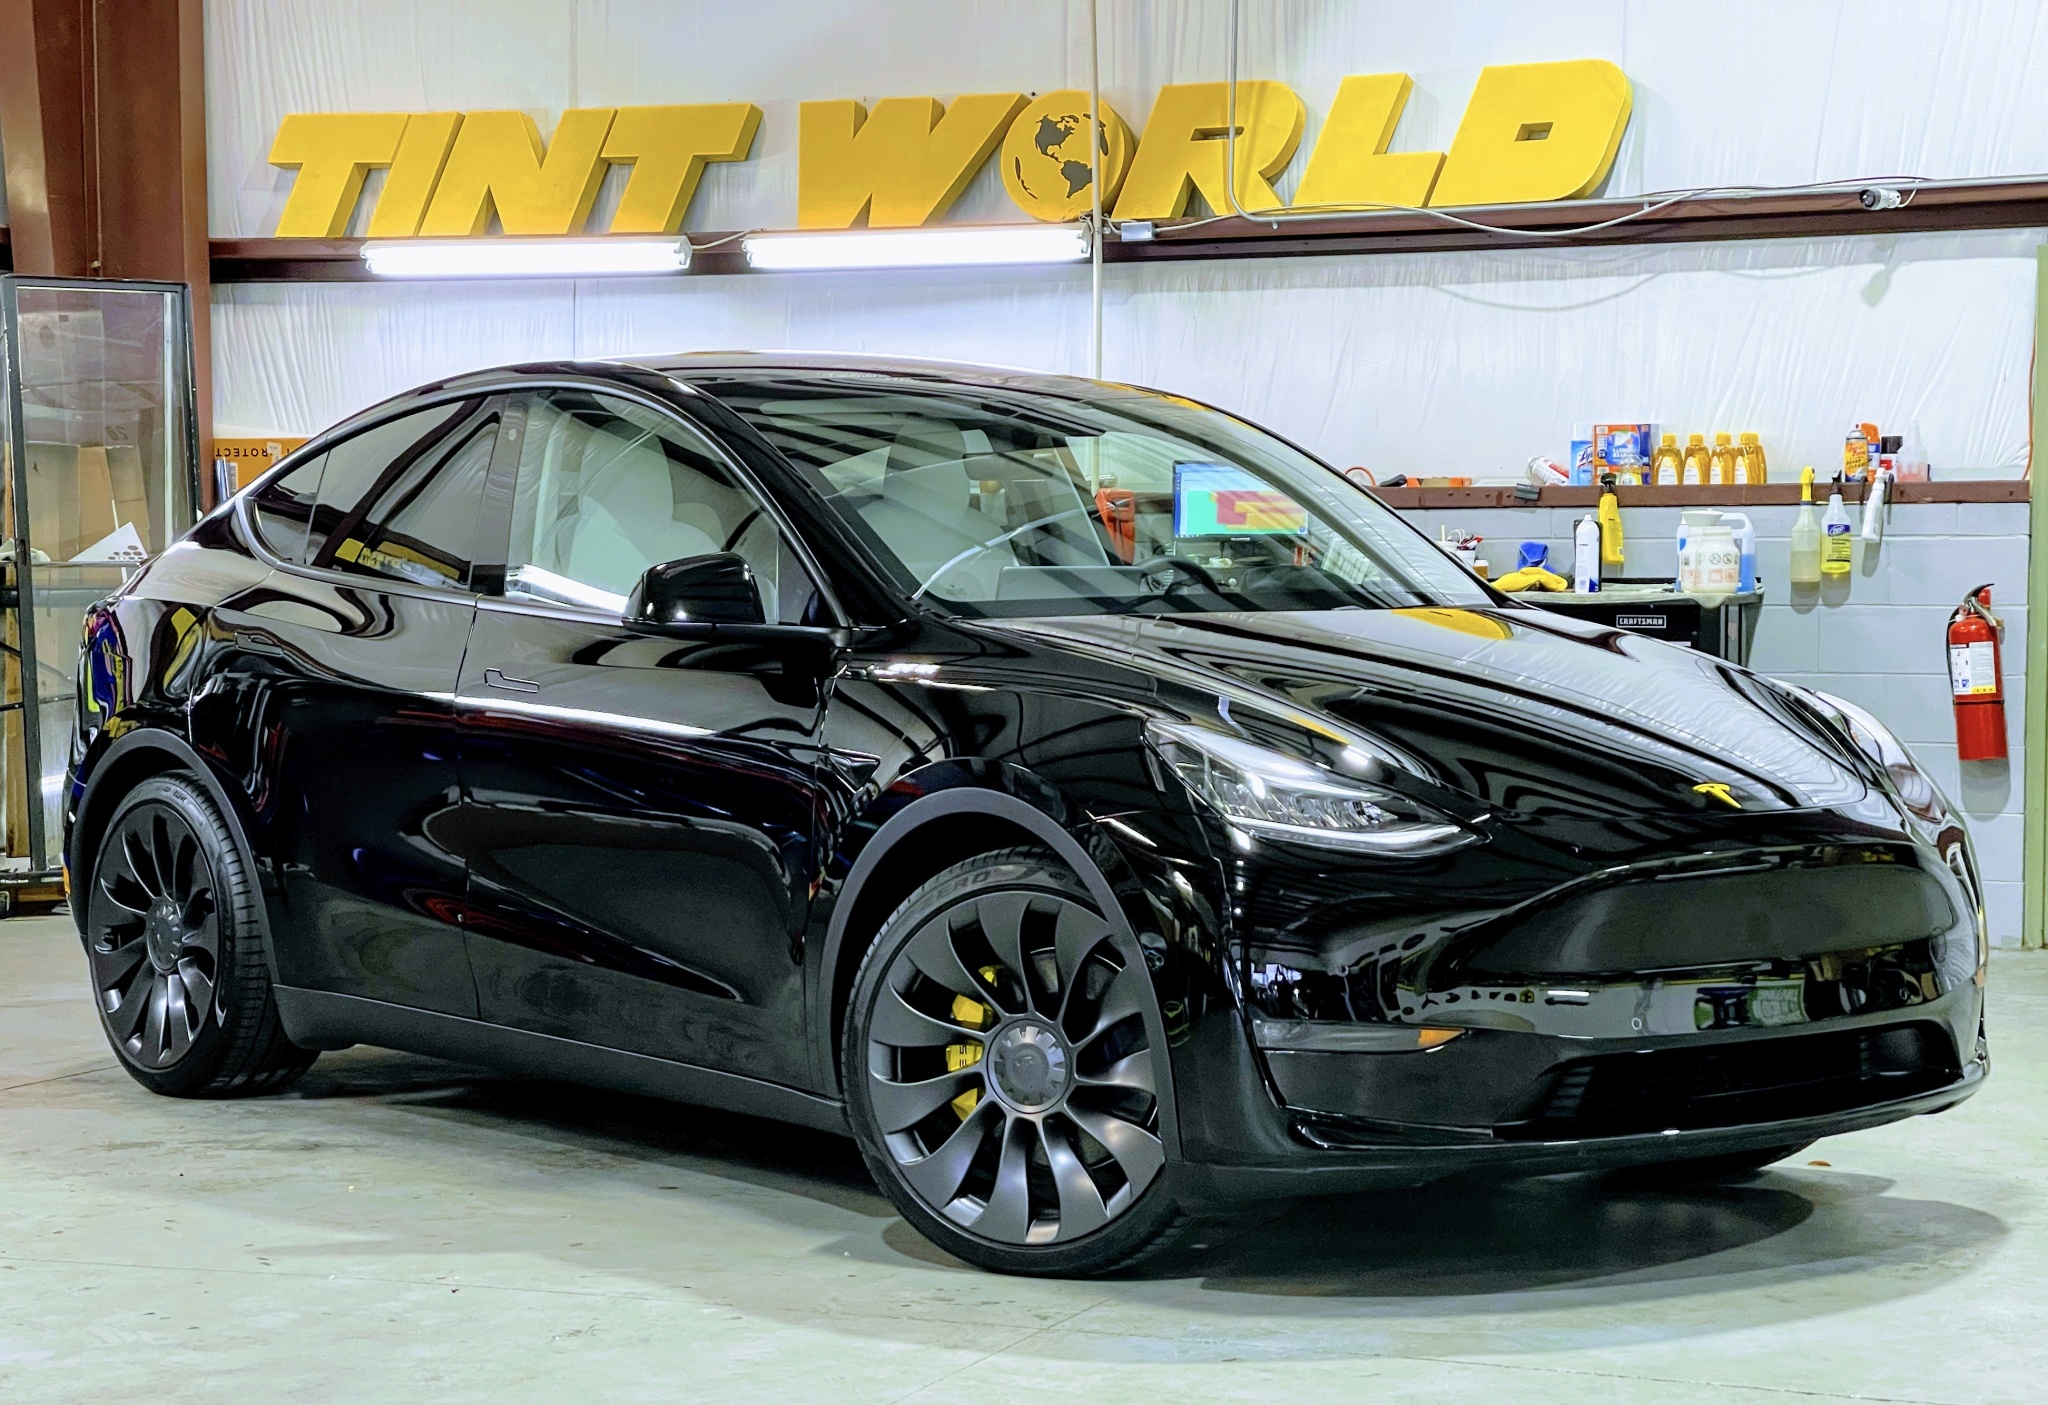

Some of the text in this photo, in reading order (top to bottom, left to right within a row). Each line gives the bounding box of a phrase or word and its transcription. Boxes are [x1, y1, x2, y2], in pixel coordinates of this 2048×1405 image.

[269, 59, 1634, 238] TINT WORLD
[215, 448, 272, 457] ROTECT
[1579, 450, 1593, 463] Lys
